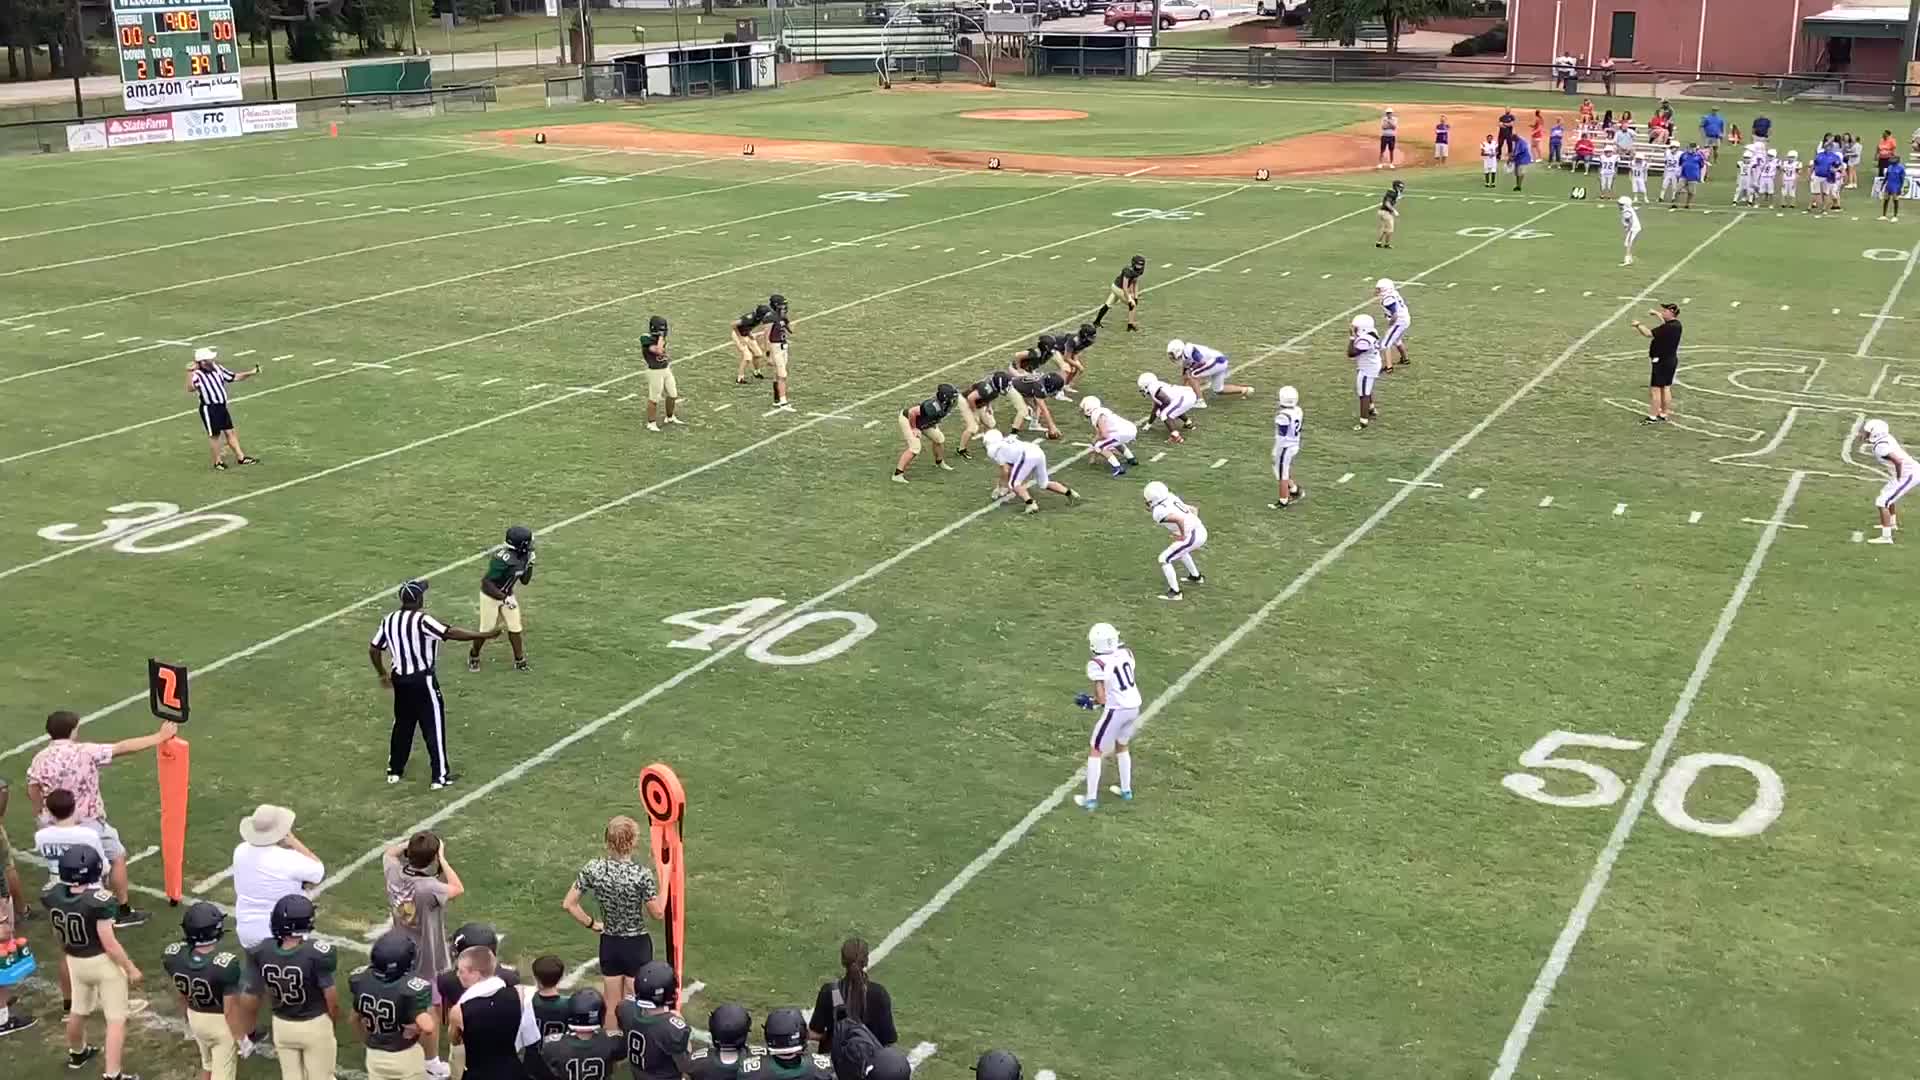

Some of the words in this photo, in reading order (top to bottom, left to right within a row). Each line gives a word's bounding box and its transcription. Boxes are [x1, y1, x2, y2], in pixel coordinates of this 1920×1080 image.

[165, 11, 197, 30] 9:06
[121, 27, 143, 47] 00
[212, 22, 232, 41] 00
[137, 60, 147, 79] 2
[159, 58, 175, 77] 15
[191, 56, 211, 76] 39
[126, 80, 183, 99] amazon
[203, 112, 224, 124] FTC
[988, 157, 1000, 169] 20
[1571, 186, 1586, 199] 40
[36, 501, 249, 554] 30
[660, 597, 879, 666] 40
[1113, 660, 1136, 692] 10
[157, 666, 182, 710] 2
[1500, 729, 1785, 837] 50
[262, 963, 306, 1006] 63
[357, 992, 398, 1035] 62
